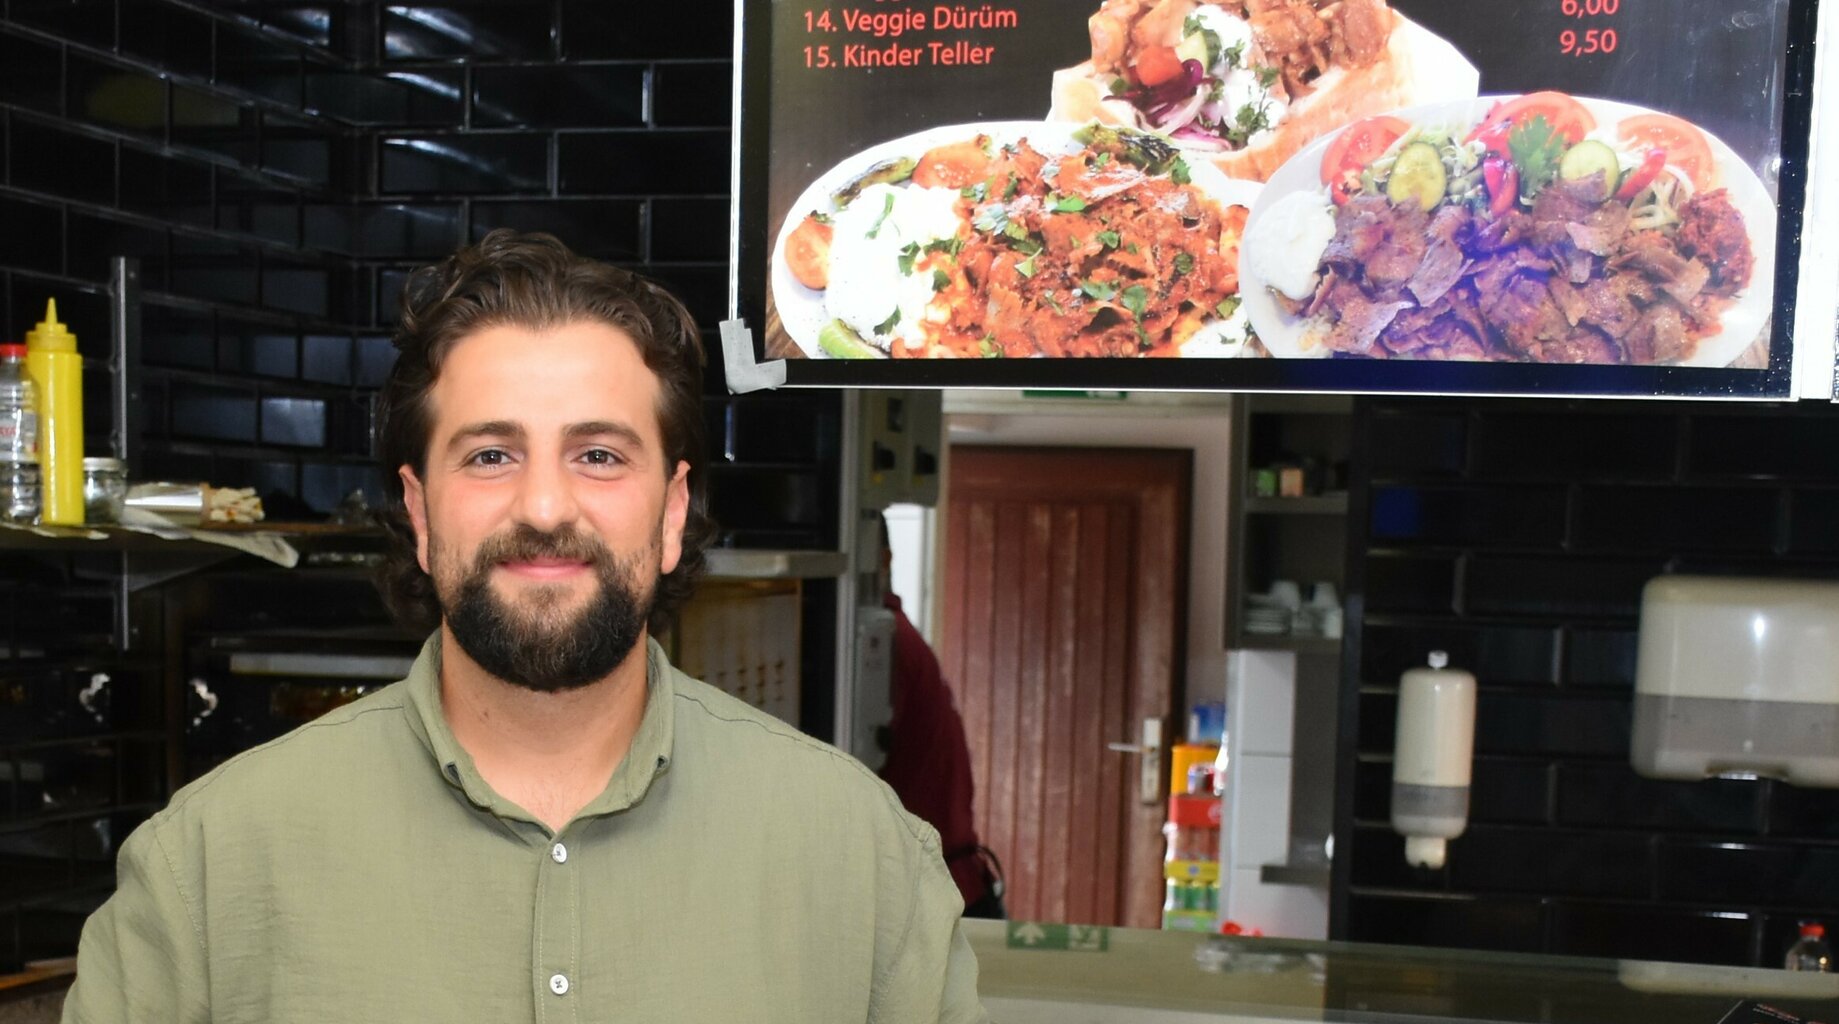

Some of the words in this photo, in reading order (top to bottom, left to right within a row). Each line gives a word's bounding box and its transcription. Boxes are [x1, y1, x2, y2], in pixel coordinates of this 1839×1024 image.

[804, 9, 838, 33] 14.
[842, 7, 927, 38] Veggie
[932, 5, 1019, 31] Dürüm
[803, 45, 837, 69] 15.
[843, 42, 923, 68] Kinder
[927, 40, 996, 66] Teller
[1559, 28, 1618, 57] 9,50
